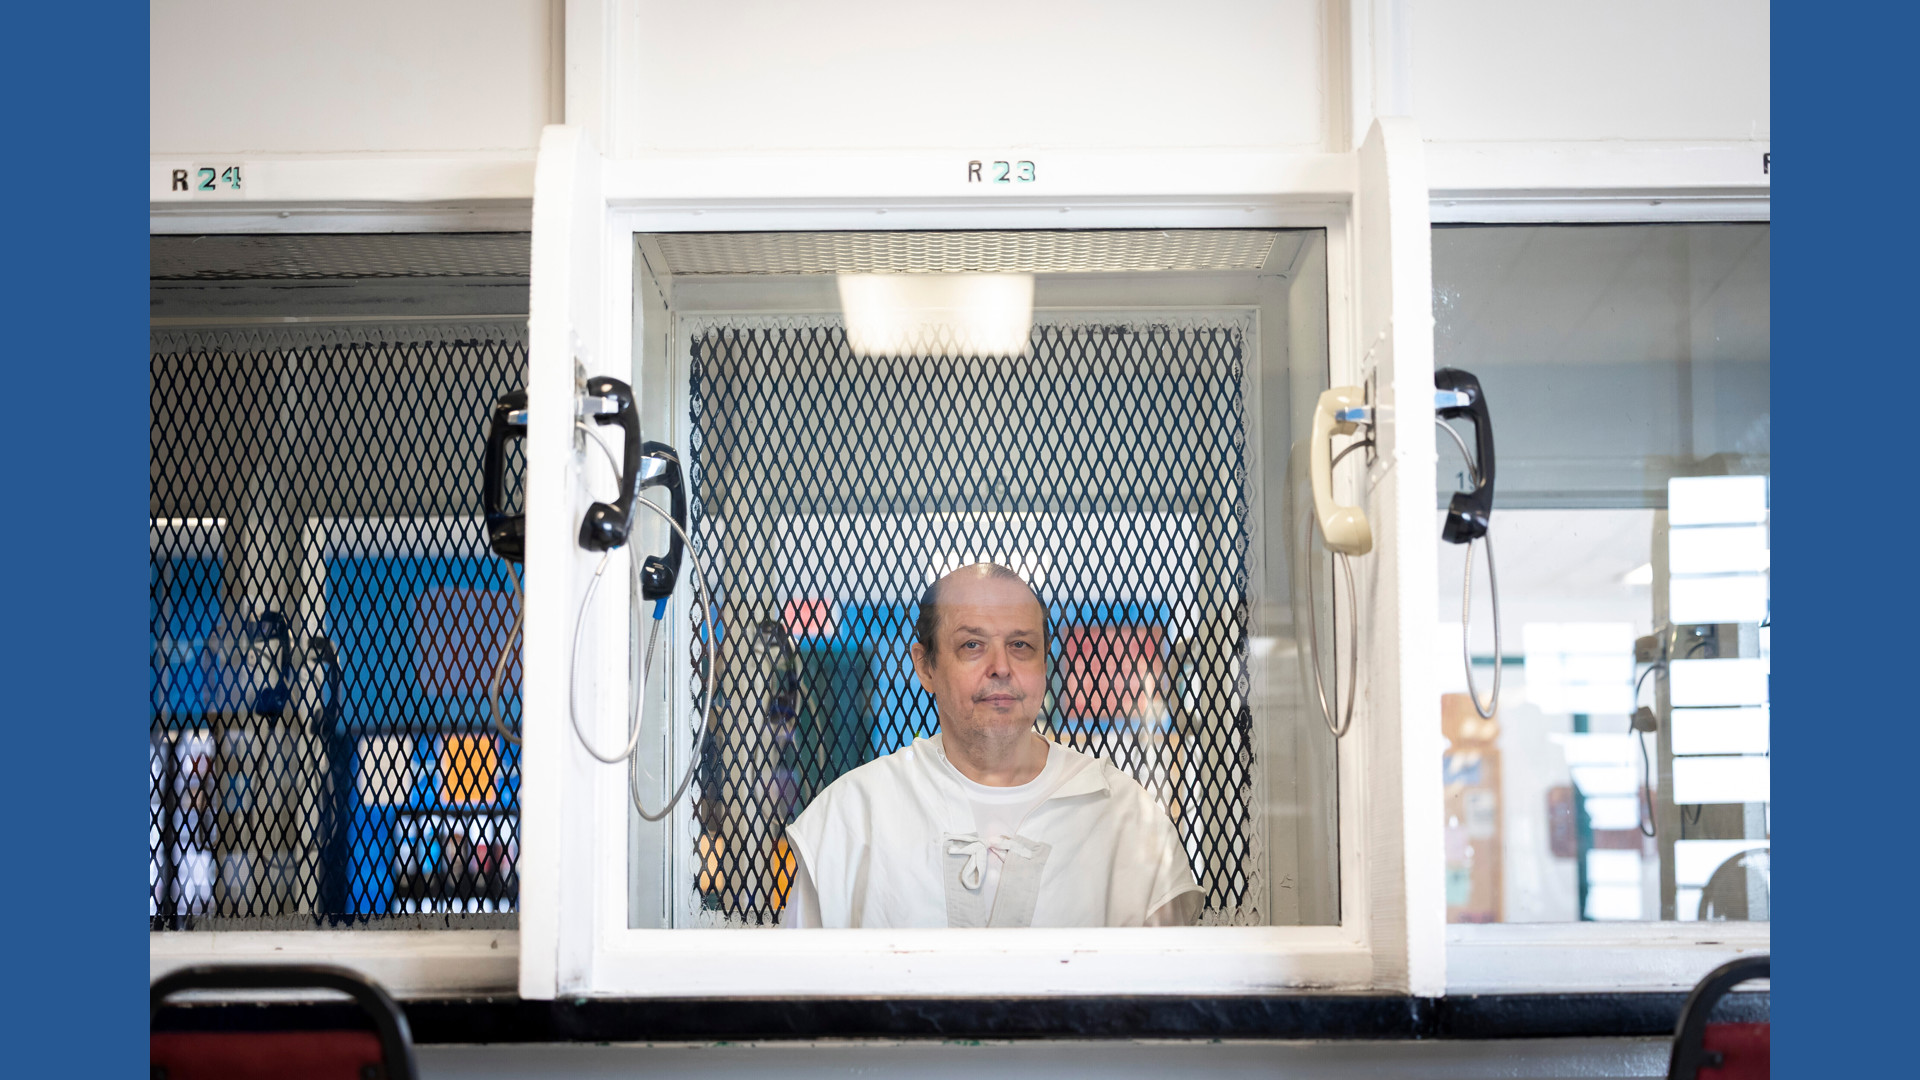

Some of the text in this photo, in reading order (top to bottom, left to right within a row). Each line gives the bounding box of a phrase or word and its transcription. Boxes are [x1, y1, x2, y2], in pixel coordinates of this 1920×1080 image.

[172, 166, 241, 191] R 24
[968, 160, 1036, 183] R 23
